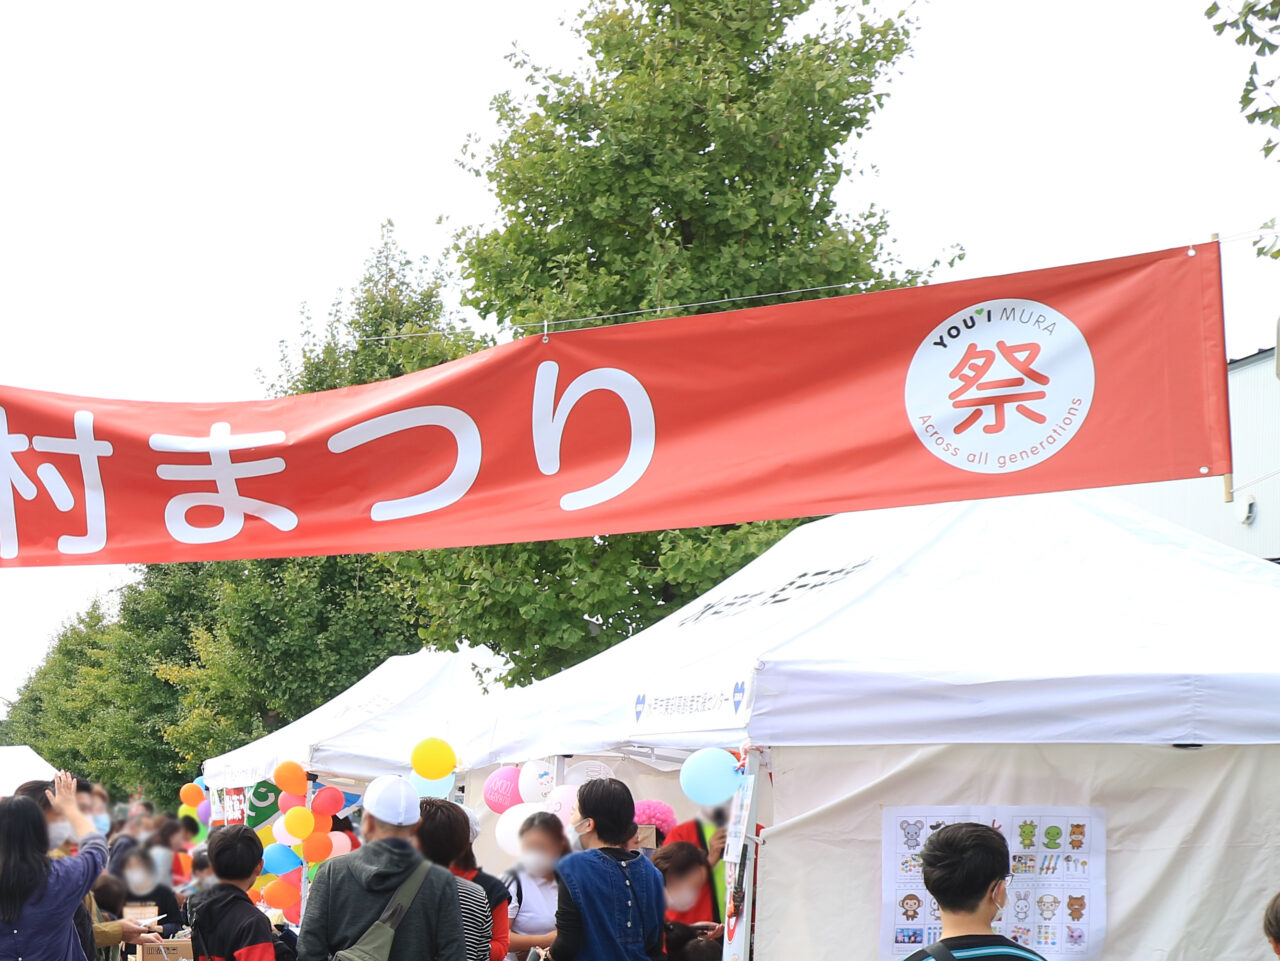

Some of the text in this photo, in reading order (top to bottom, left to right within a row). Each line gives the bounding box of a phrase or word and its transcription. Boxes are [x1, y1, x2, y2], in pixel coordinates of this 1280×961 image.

[999, 307, 1057, 336] MURA
[948, 340, 1050, 435] 祭
[919, 397, 1083, 469] Across all generations
